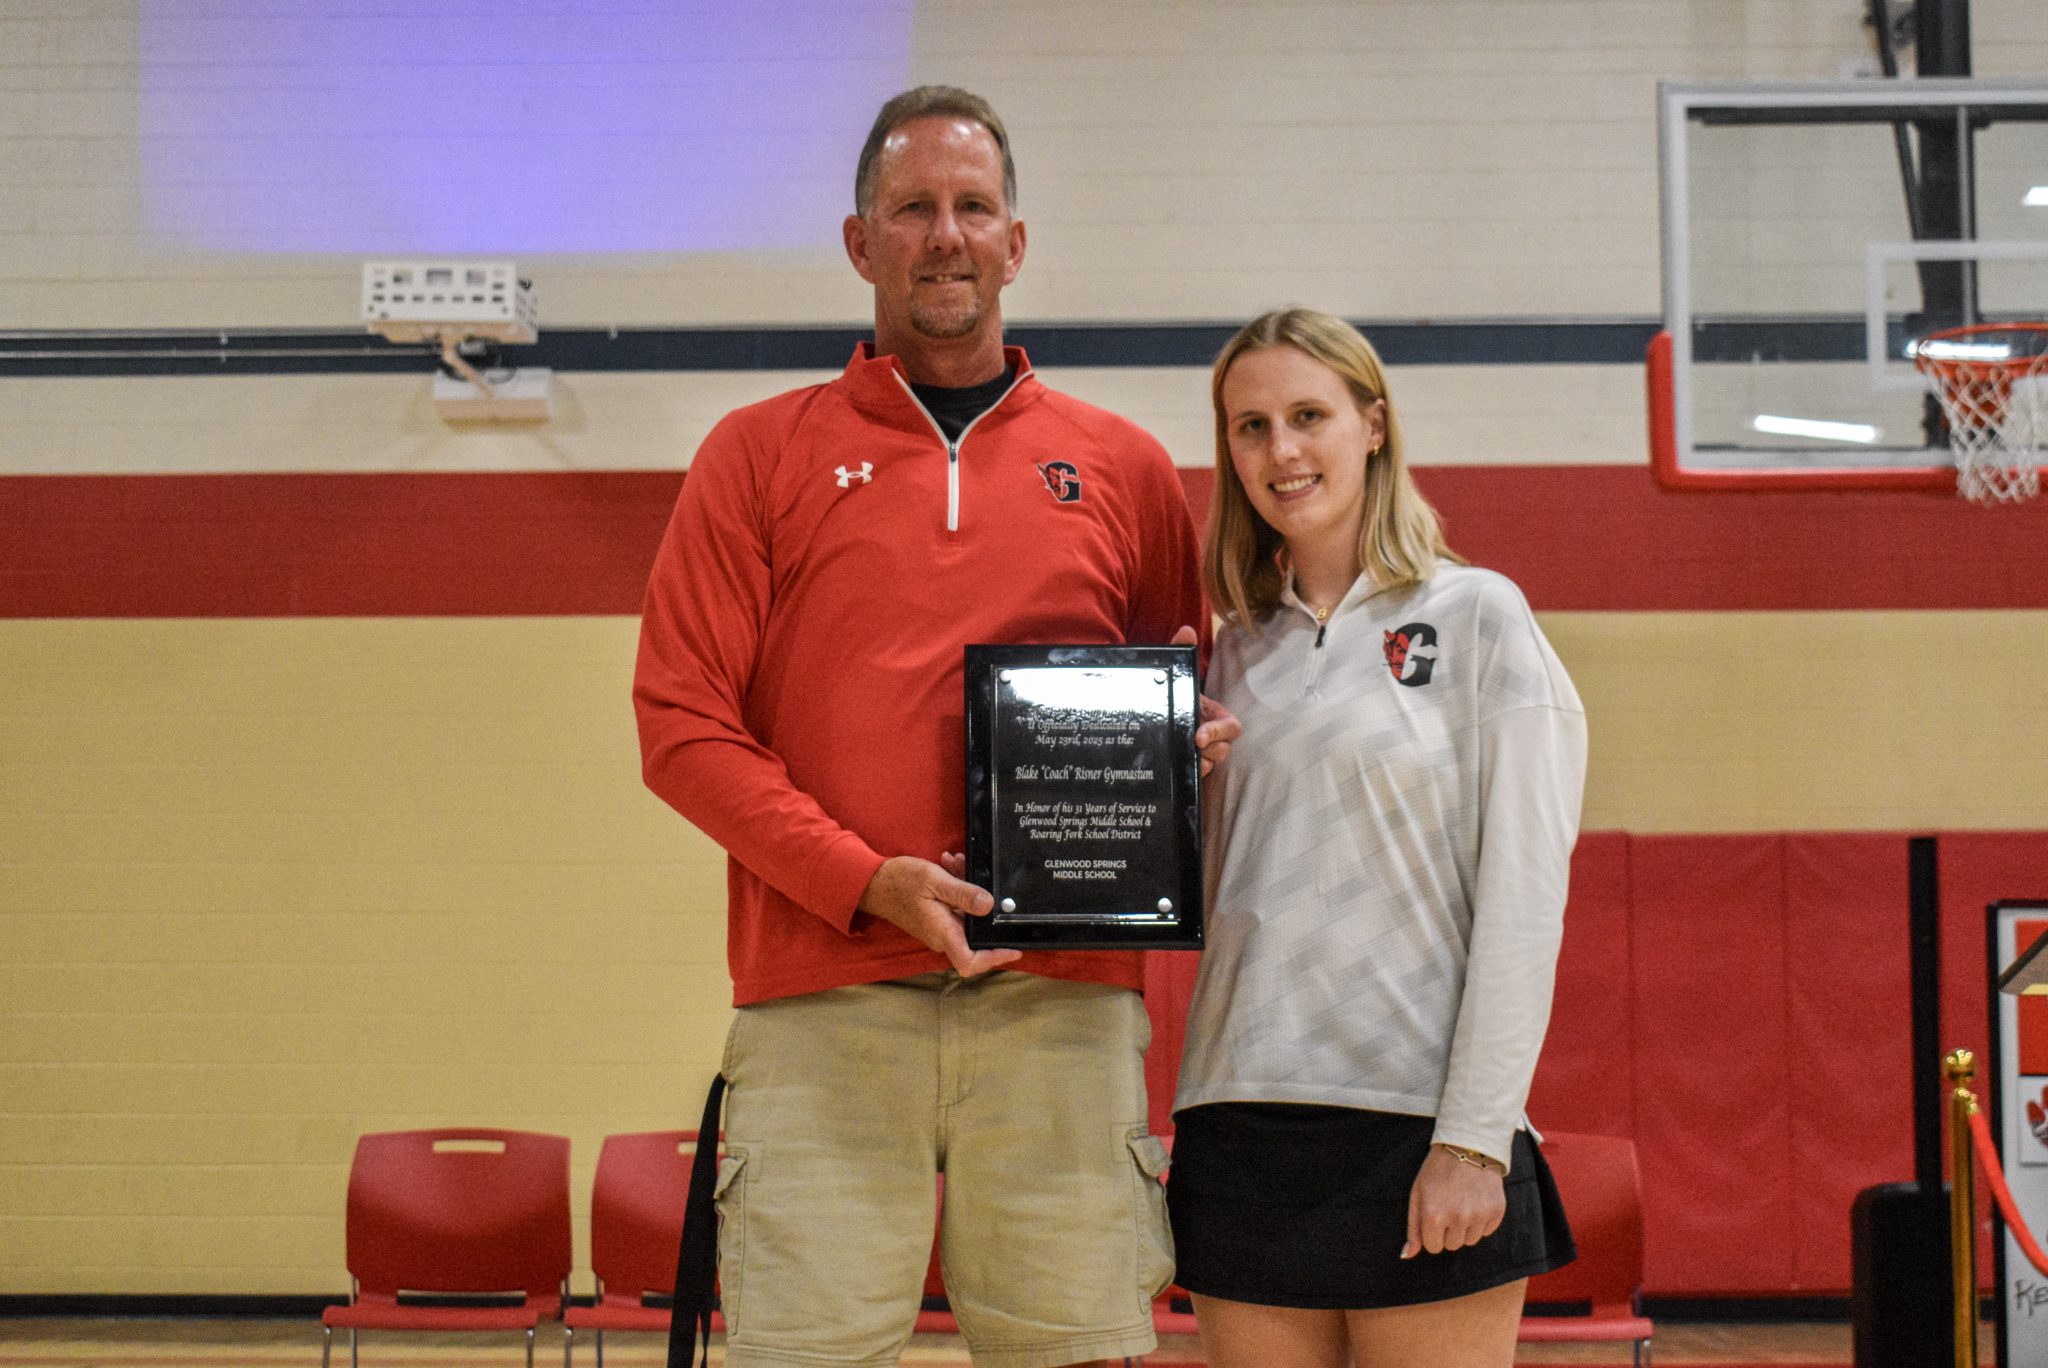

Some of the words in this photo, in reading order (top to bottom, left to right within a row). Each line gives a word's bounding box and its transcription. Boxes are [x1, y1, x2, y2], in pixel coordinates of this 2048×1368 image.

[1386, 622, 1438, 687] G
[1035, 734, 1057, 748] May
[1058, 733, 1081, 746] 23rd,
[1083, 736, 1103, 746] 2025
[1105, 736, 1115, 745] as
[1015, 764, 1039, 780] Blake
[1074, 766, 1102, 780] Risner
[1103, 766, 1154, 785] Gymnasium
[1014, 803, 1024, 813] In
[1025, 803, 1050, 813] Honor
[1052, 803, 1062, 816] of
[1062, 802, 1073, 813] his
[1075, 805, 1083, 814] 31
[1085, 804, 1107, 814] Years
[1108, 803, 1117, 816] of
[1118, 803, 1146, 813] Service
[1148, 805, 1157, 813] to
[1019, 815, 1058, 829] Glenwood
[1059, 816, 1088, 830] Springs
[1090, 815, 1117, 827] Middle
[1119, 815, 1144, 827] School
[1144, 817, 1151, 827] &
[1030, 829, 1062, 842] Roaring
[1063, 829, 1083, 841] Fork
[1084, 828, 1110, 840] School
[1111, 829, 1142, 840] District
[1044, 859, 1091, 868] GLENWOOD
[1093, 859, 1127, 868] SPRINGS
[1053, 870, 1083, 879] MIDDLE
[1084, 870, 1117, 879] SCHOOL
